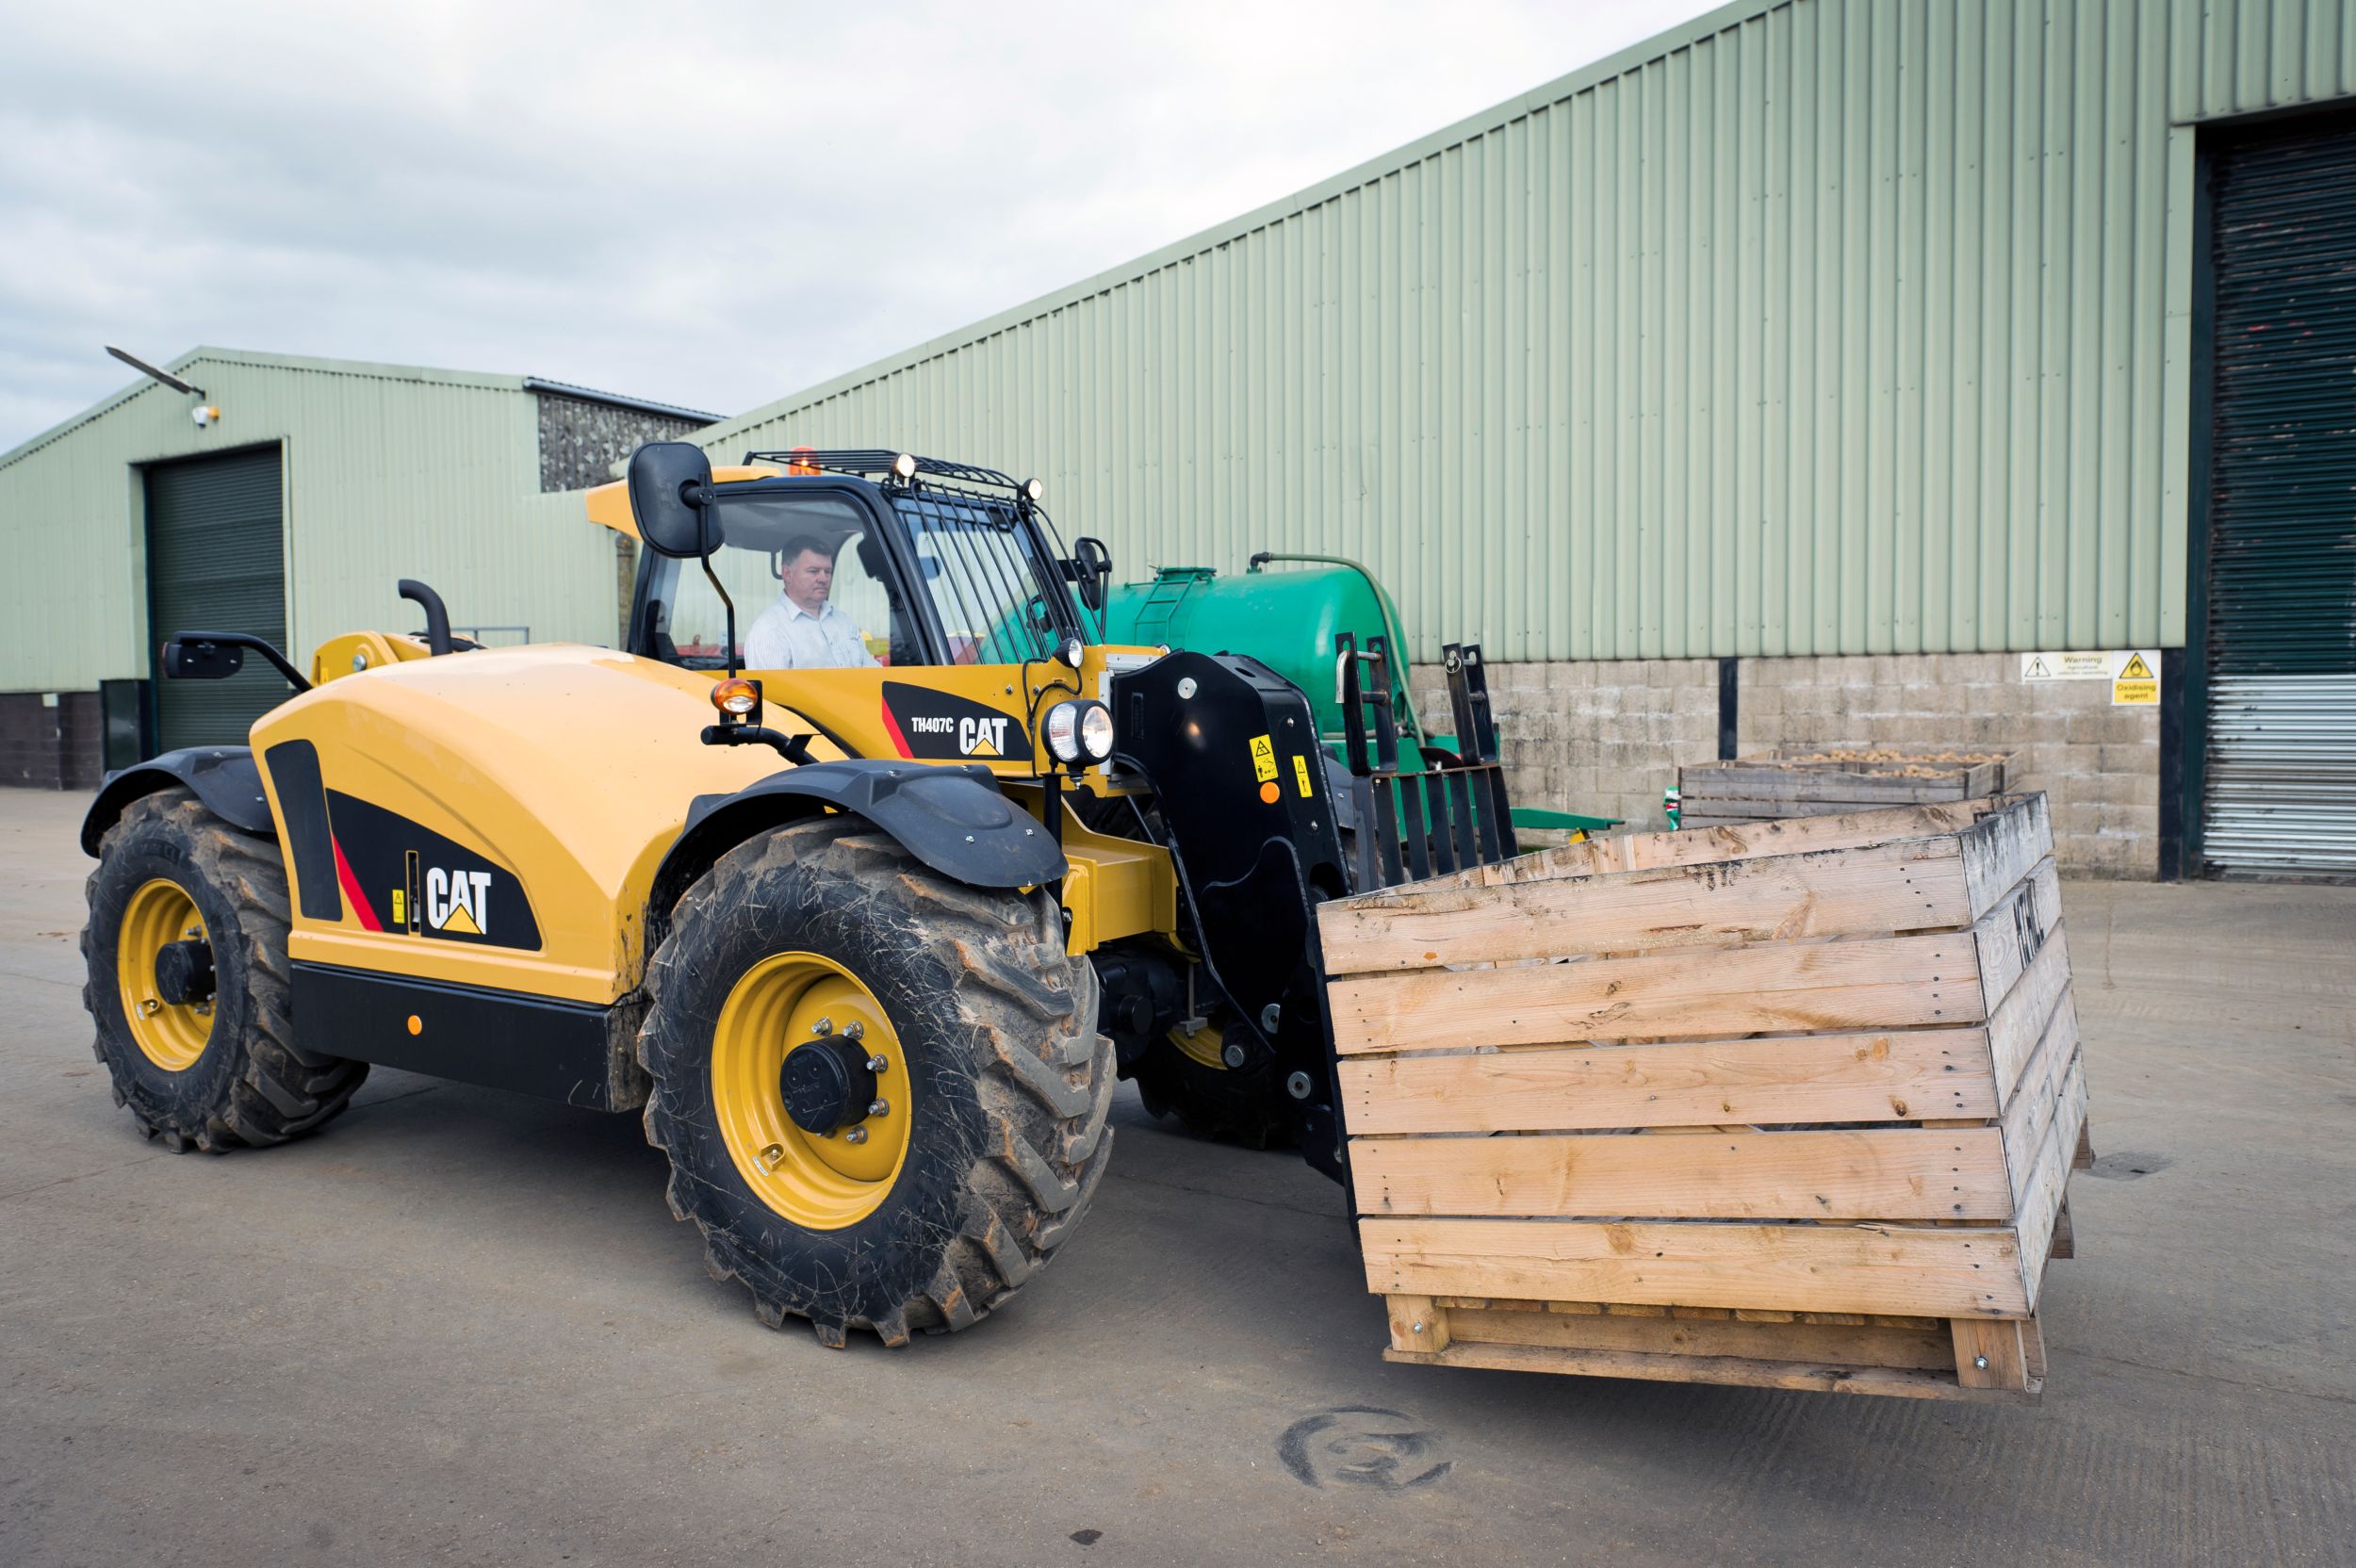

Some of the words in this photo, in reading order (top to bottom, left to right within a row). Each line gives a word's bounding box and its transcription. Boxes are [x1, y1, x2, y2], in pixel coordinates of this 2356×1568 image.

[2064, 656, 2102, 664] Warning
[2117, 684, 2156, 693] Oxidising
[911, 717, 954, 733] TH407C
[959, 717, 1008, 756] CAT
[426, 867, 492, 935] CAT
